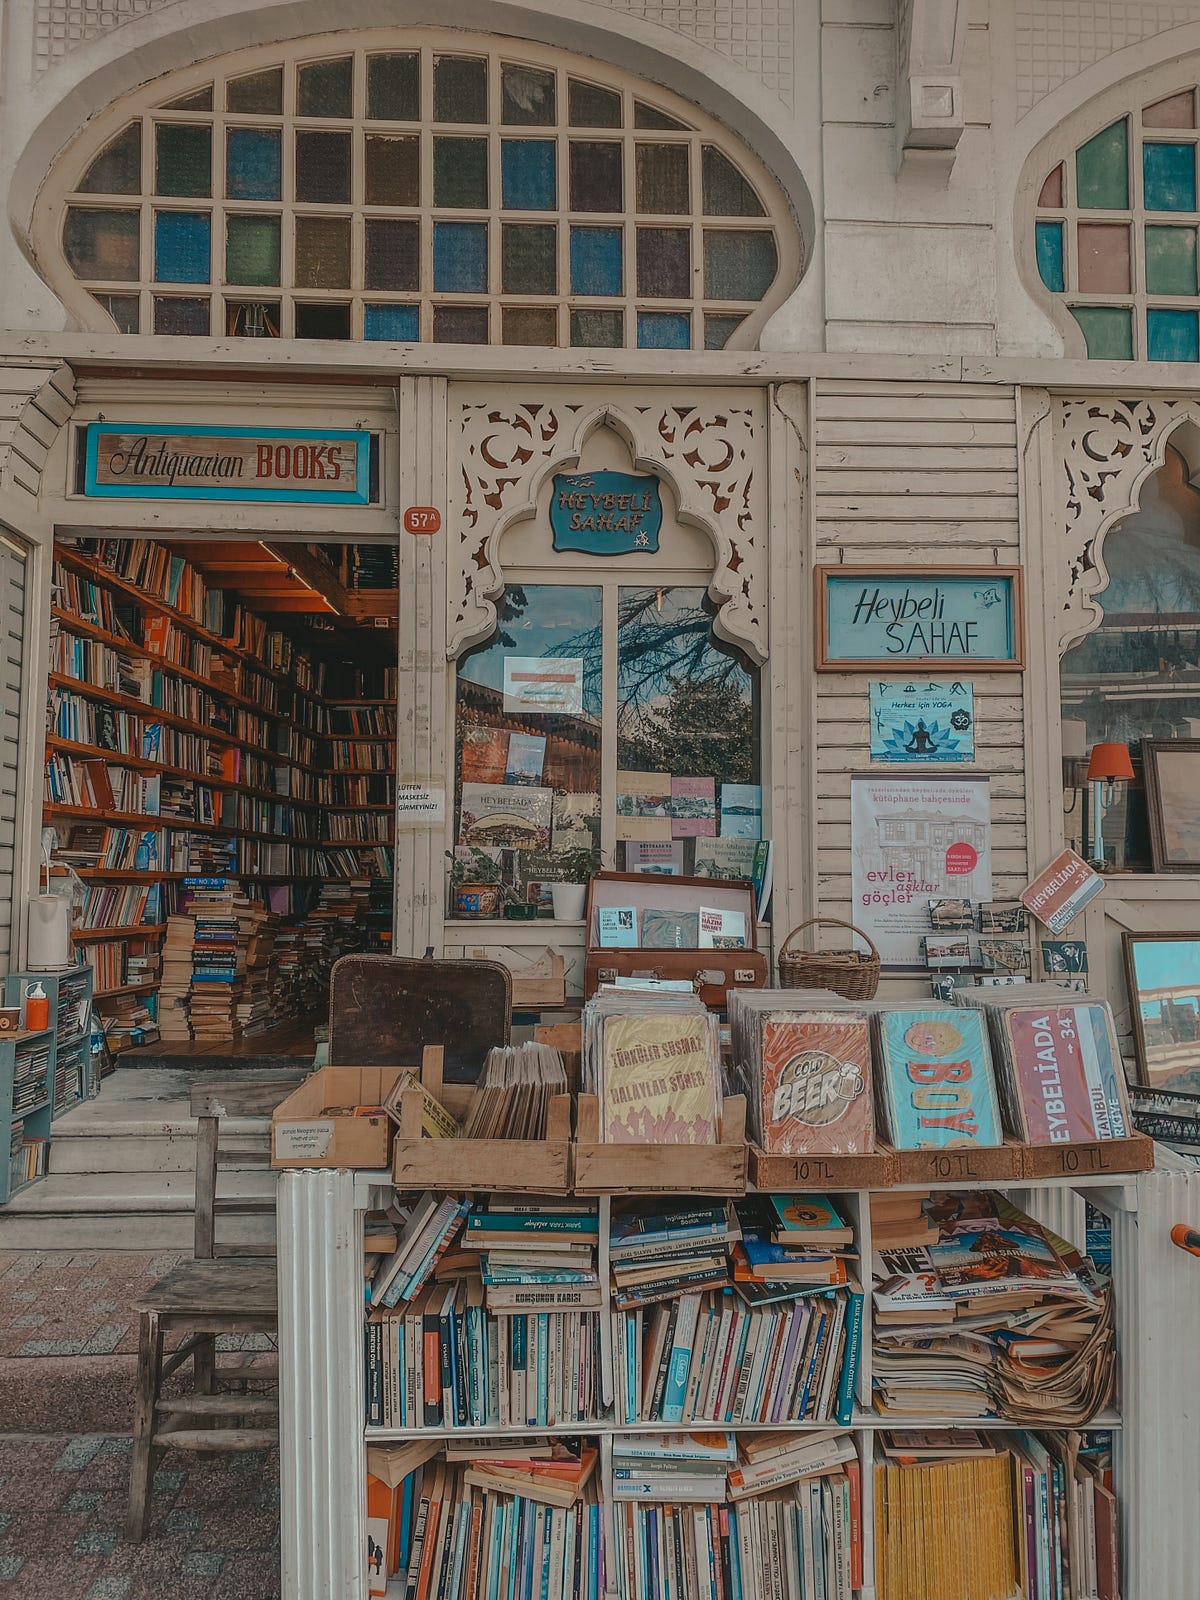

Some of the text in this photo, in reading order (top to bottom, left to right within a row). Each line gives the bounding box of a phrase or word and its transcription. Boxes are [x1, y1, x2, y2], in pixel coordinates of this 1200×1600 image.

[109, 437, 342, 486] Antiquarian BOOKS
[559, 490, 653, 511] HEYBELİ
[569, 512, 645, 532] SAHAF
[853, 588, 945, 624] Heybeli
[886, 621, 978, 653] SAHAF
[891, 701, 952, 710] Herkes için YOGA
[398, 793, 429, 801] MASKESİZ
[398, 803, 438, 811] GİRMEYİNİZ!
[873, 794, 971, 804] kütüphane bahçesinde
[867, 866, 915, 882] evler
[1079, 870, 1089, 881] 34
[896, 880, 940, 894] aşklar
[1029, 859, 1082, 911] HEYBELİADA
[862, 890, 913, 907] göçler
[1058, 1017, 1076, 1040] 34
[611, 1044, 661, 1069] TÜRKÜLER
[794, 1058, 823, 1078] COLD
[1032, 1015, 1070, 1143] EYBELİADA
[610, 1078, 668, 1105] HALAYLAR
[772, 1070, 842, 1121] BEER
[905, 1059, 979, 1137] BOY
[931, 1155, 977, 1177] 10 TL
[1057, 1148, 1110, 1172] 10 TL
[793, 1161, 834, 1181] 10 TL
[880, 1254, 935, 1274] NE
[515, 1293, 581, 1305] KOMŞUNUN KARISI
[852, 1317, 860, 1334] TARA
